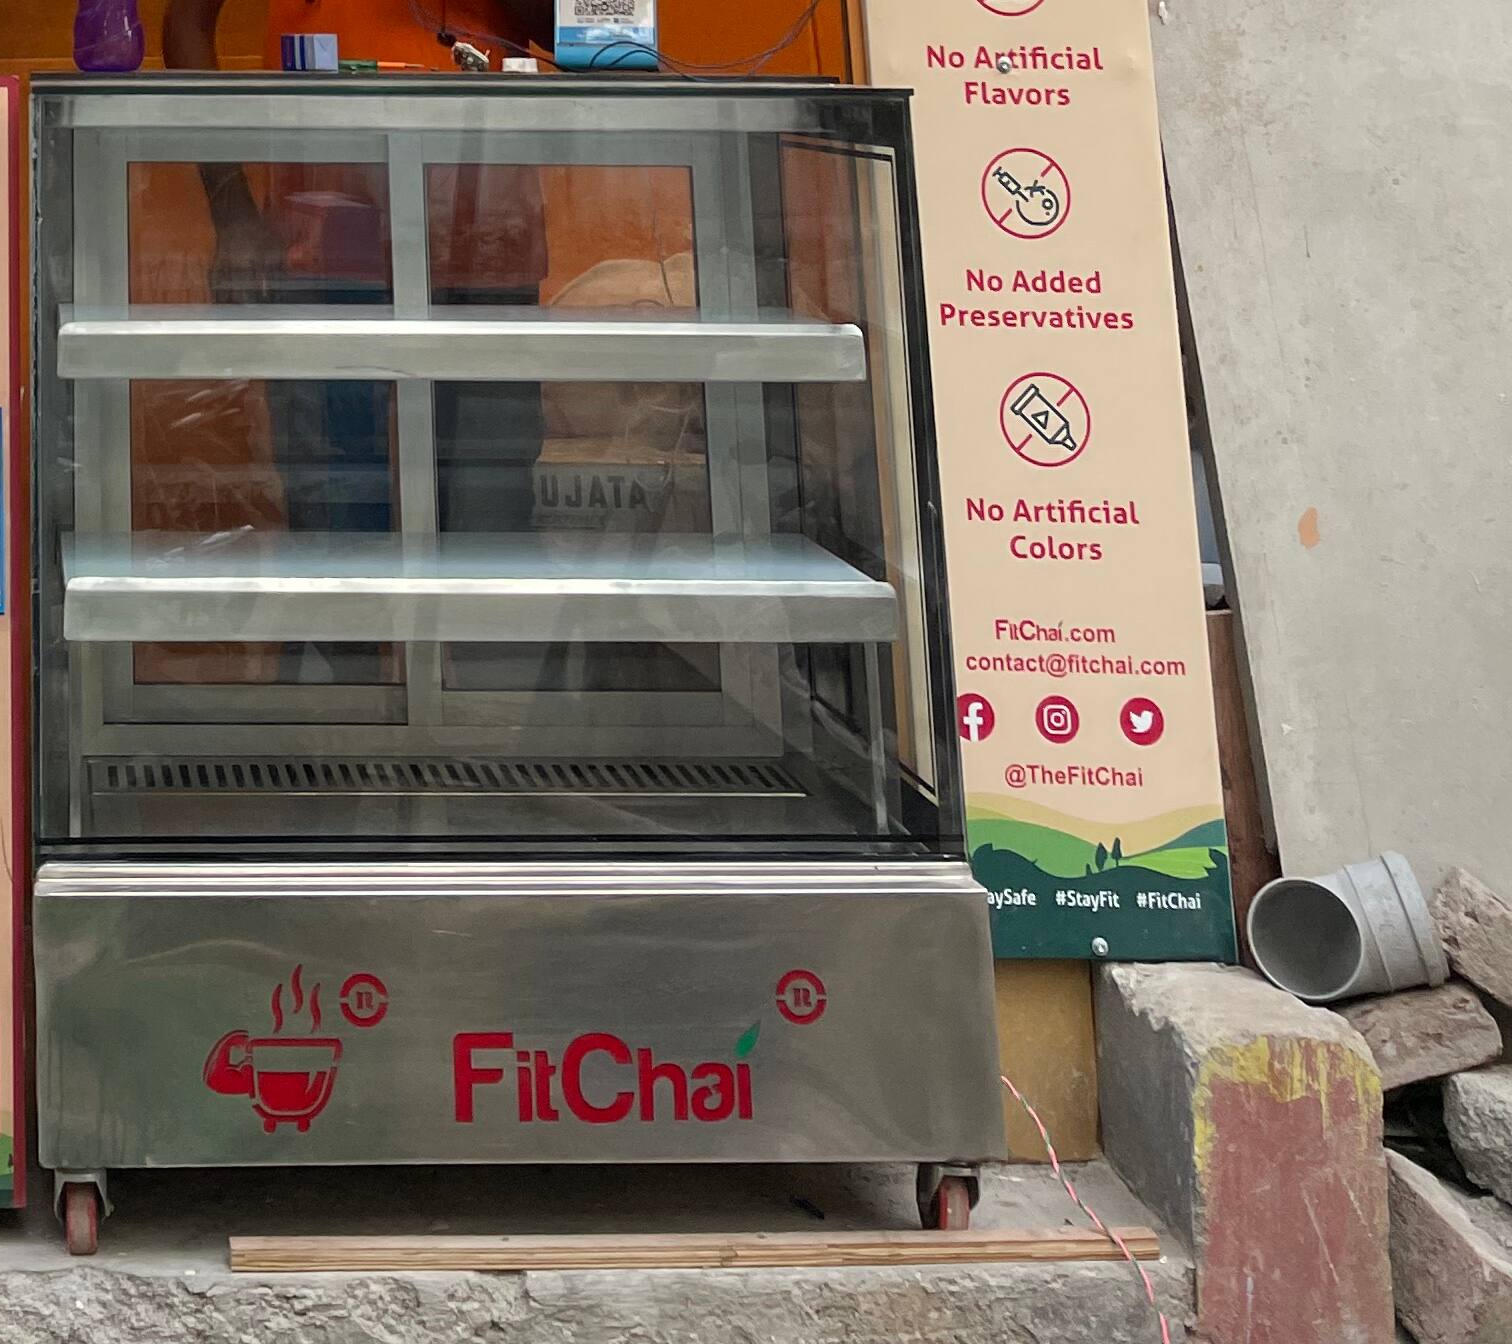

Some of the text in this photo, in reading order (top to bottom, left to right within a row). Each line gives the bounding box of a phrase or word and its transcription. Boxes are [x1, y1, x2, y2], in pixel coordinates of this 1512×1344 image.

[927, 45, 1104, 71] No Artificial
[964, 82, 1071, 106] Flavors
[966, 269, 1102, 294] No Added
[940, 303, 1134, 330] Preservatives
[540, 475, 648, 509] UJATA
[966, 498, 1140, 526] No Artificial
[1009, 536, 1103, 561] Colors
[995, 618, 1116, 644] FitChai.com
[965, 652, 1186, 678] contact@fitchai.com
[1004, 764, 1144, 788] @TheFitChai
[987, 889, 1201, 912] aySafe #StayFit #FitChai
[453, 1020, 761, 1124] FitChai
